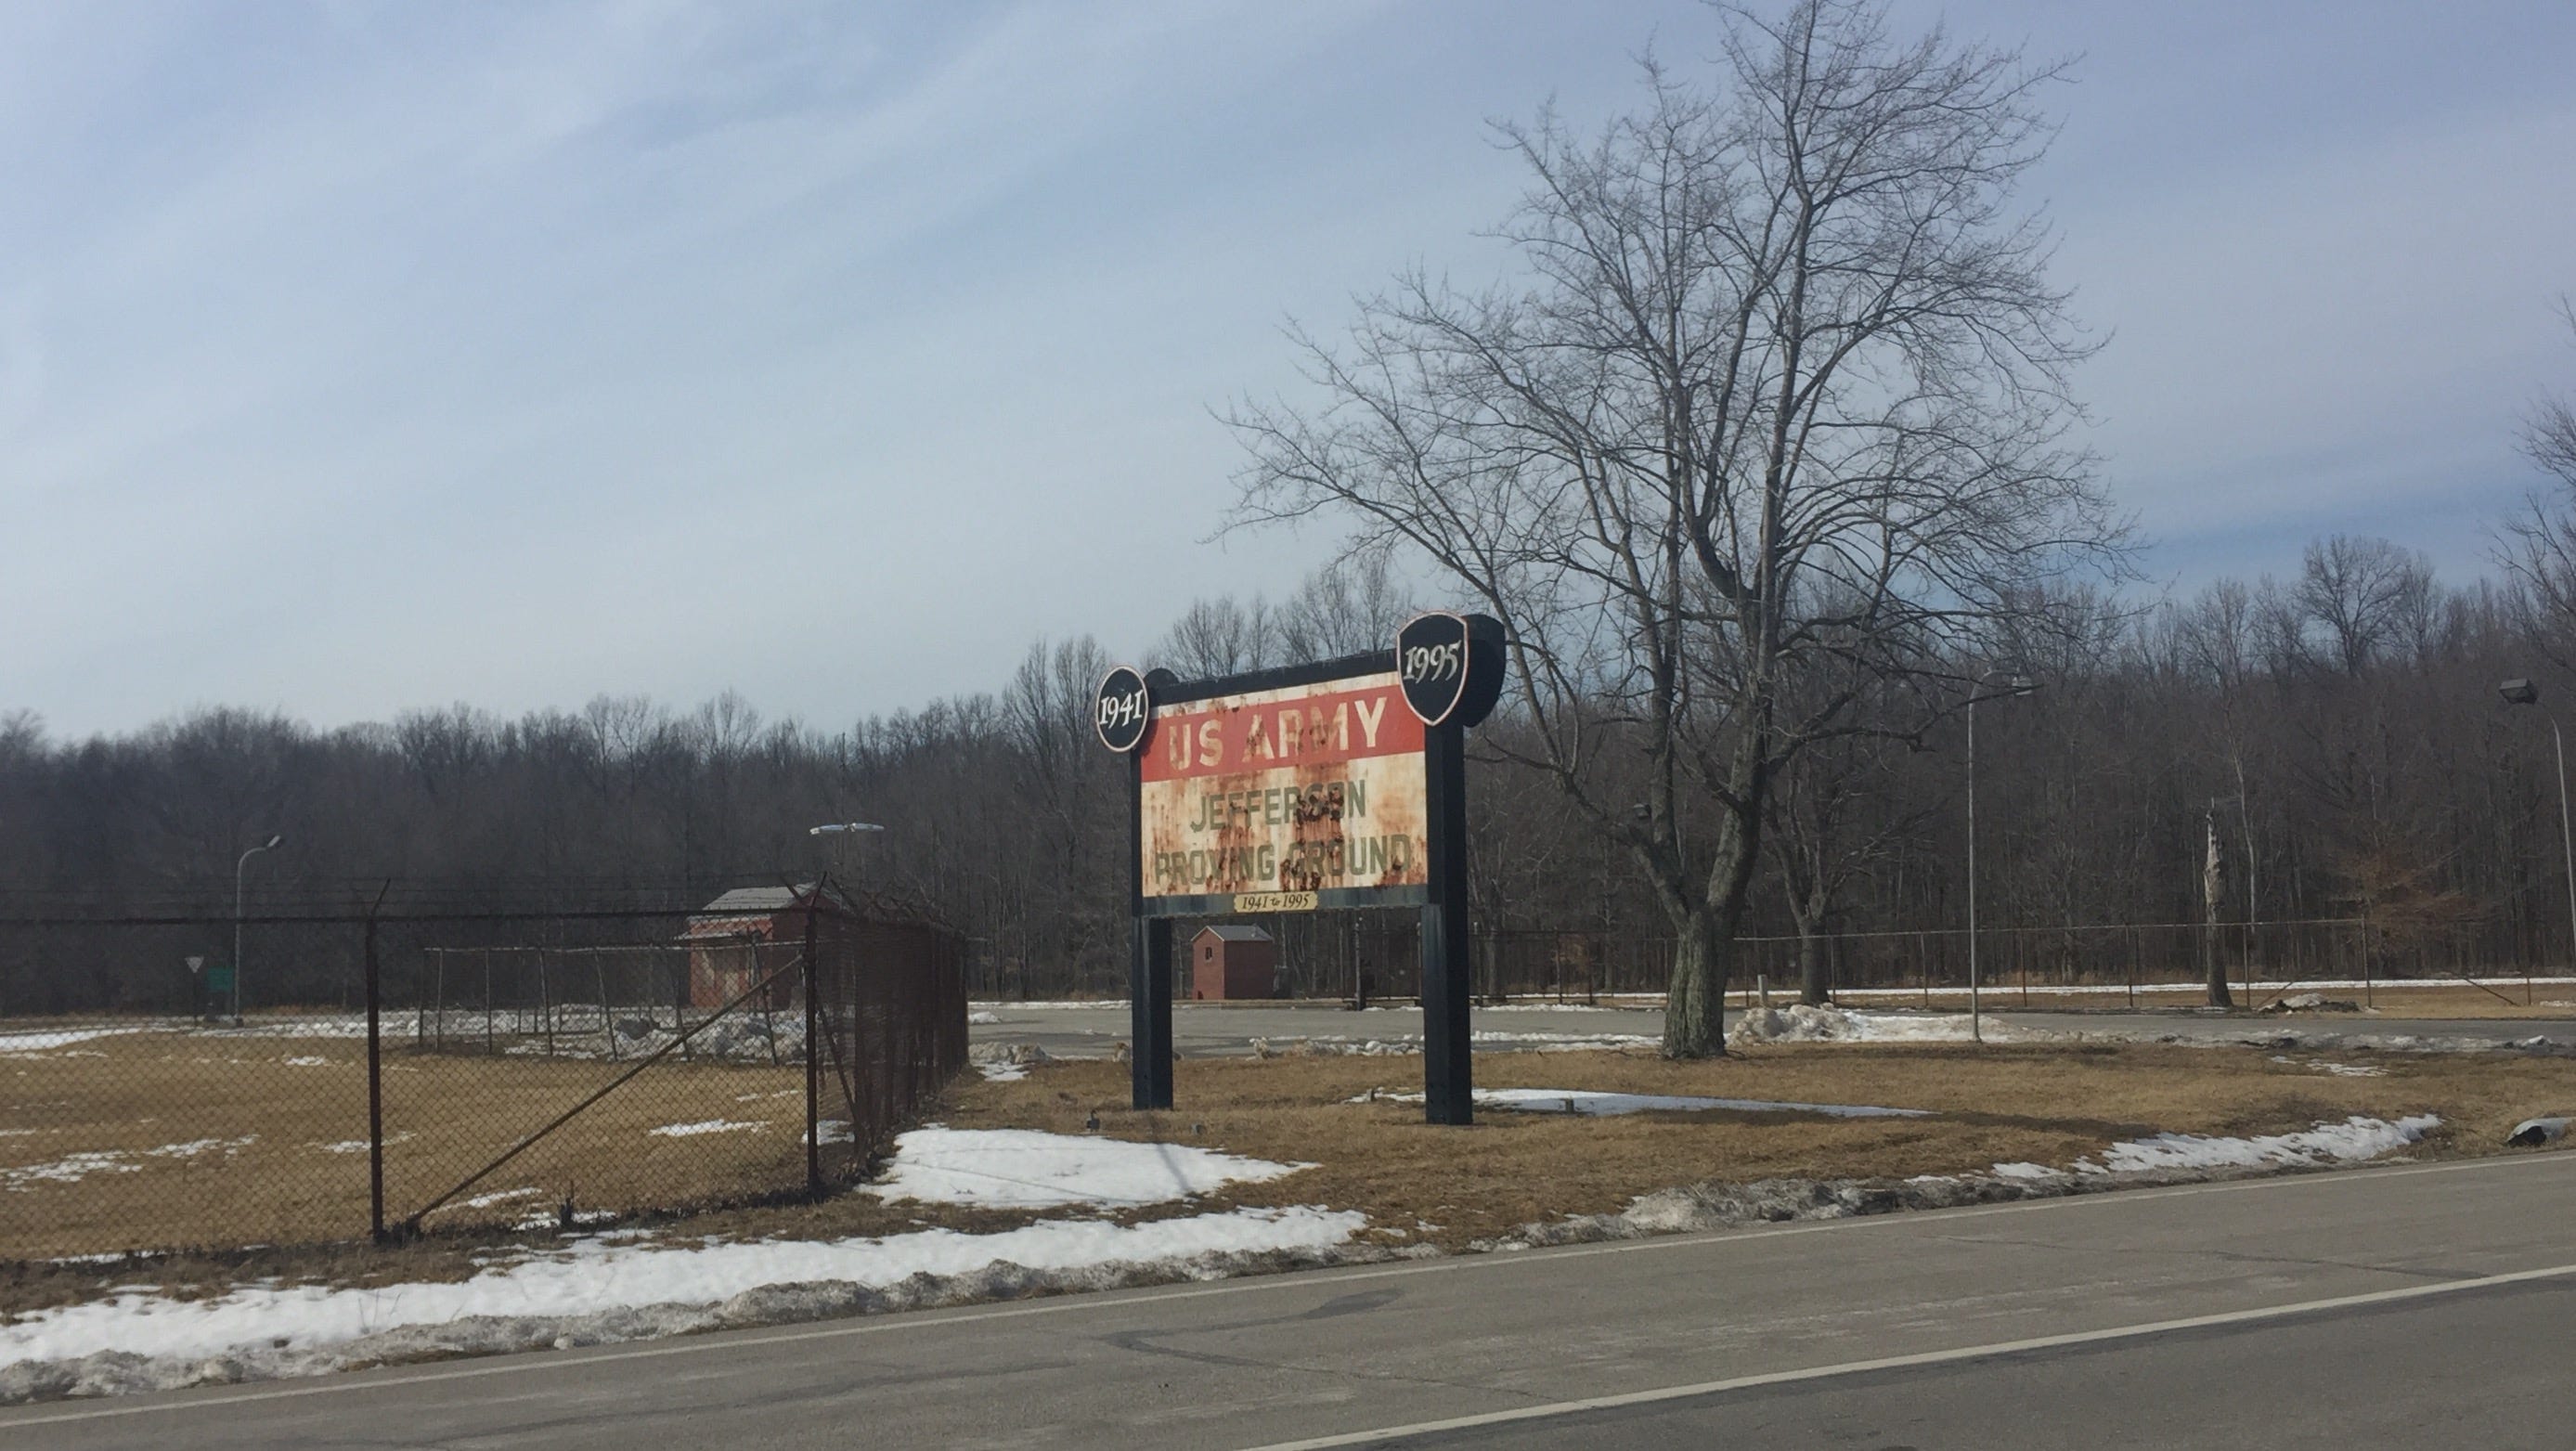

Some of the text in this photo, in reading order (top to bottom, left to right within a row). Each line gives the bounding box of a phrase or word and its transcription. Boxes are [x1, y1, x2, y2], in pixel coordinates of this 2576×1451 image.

[1403, 641, 1463, 683] 1995
[1099, 689, 1145, 728] 1941
[1169, 697, 1387, 771] US ARMY
[1190, 779, 1366, 833] JEFFERSON
[1155, 834, 1412, 885] PROVING GROUND
[1242, 895, 1310, 910] 1941 to 1995
